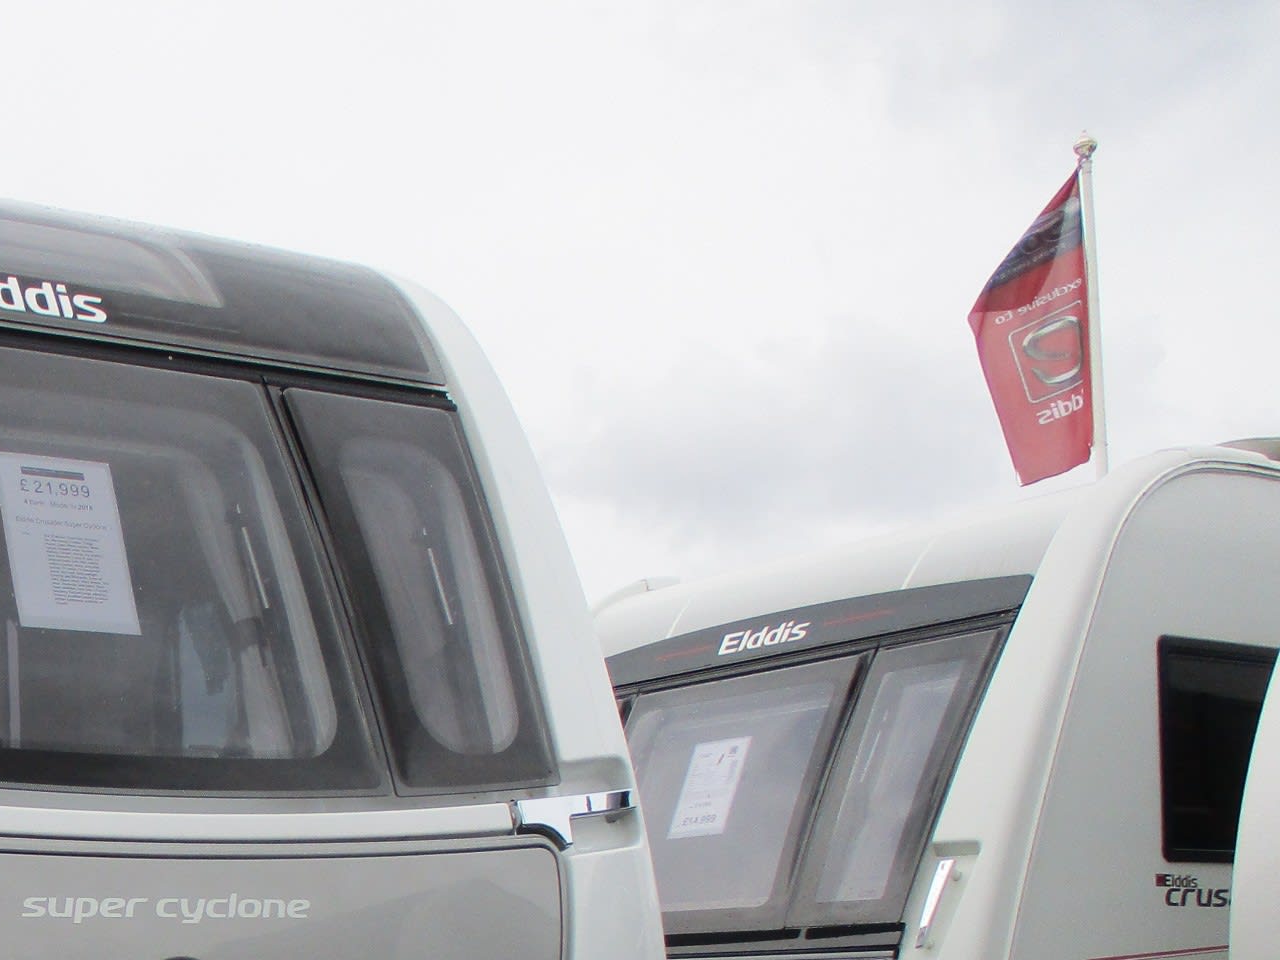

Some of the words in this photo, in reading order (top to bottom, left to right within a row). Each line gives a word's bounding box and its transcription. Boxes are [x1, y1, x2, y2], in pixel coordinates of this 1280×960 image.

[717, 620, 813, 656] Elddis
[1163, 873, 1198, 888] Elddis
[21, 896, 149, 924] super
[155, 892, 311, 924] cyclone
[1165, 887, 1231, 907] crus
